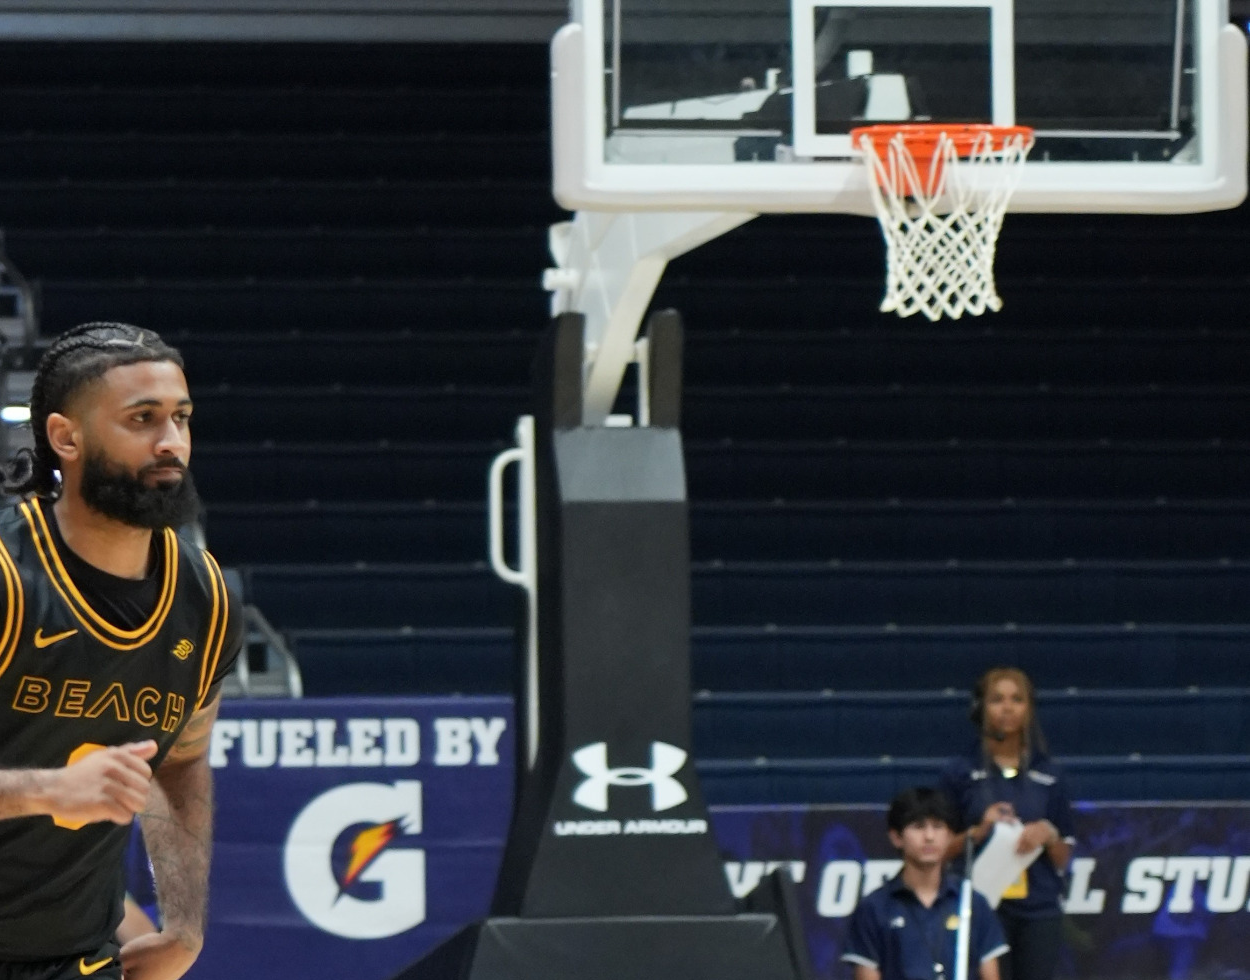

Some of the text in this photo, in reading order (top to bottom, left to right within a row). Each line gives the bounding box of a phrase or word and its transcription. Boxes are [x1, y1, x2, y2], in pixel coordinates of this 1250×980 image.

[12, 675, 185, 732] BEACH
[208, 717, 507, 768] FUELED BY
[554, 819, 708, 836] UNDER ARMOUR
[284, 779, 427, 940] G
[1120, 855, 1250, 914] STU
